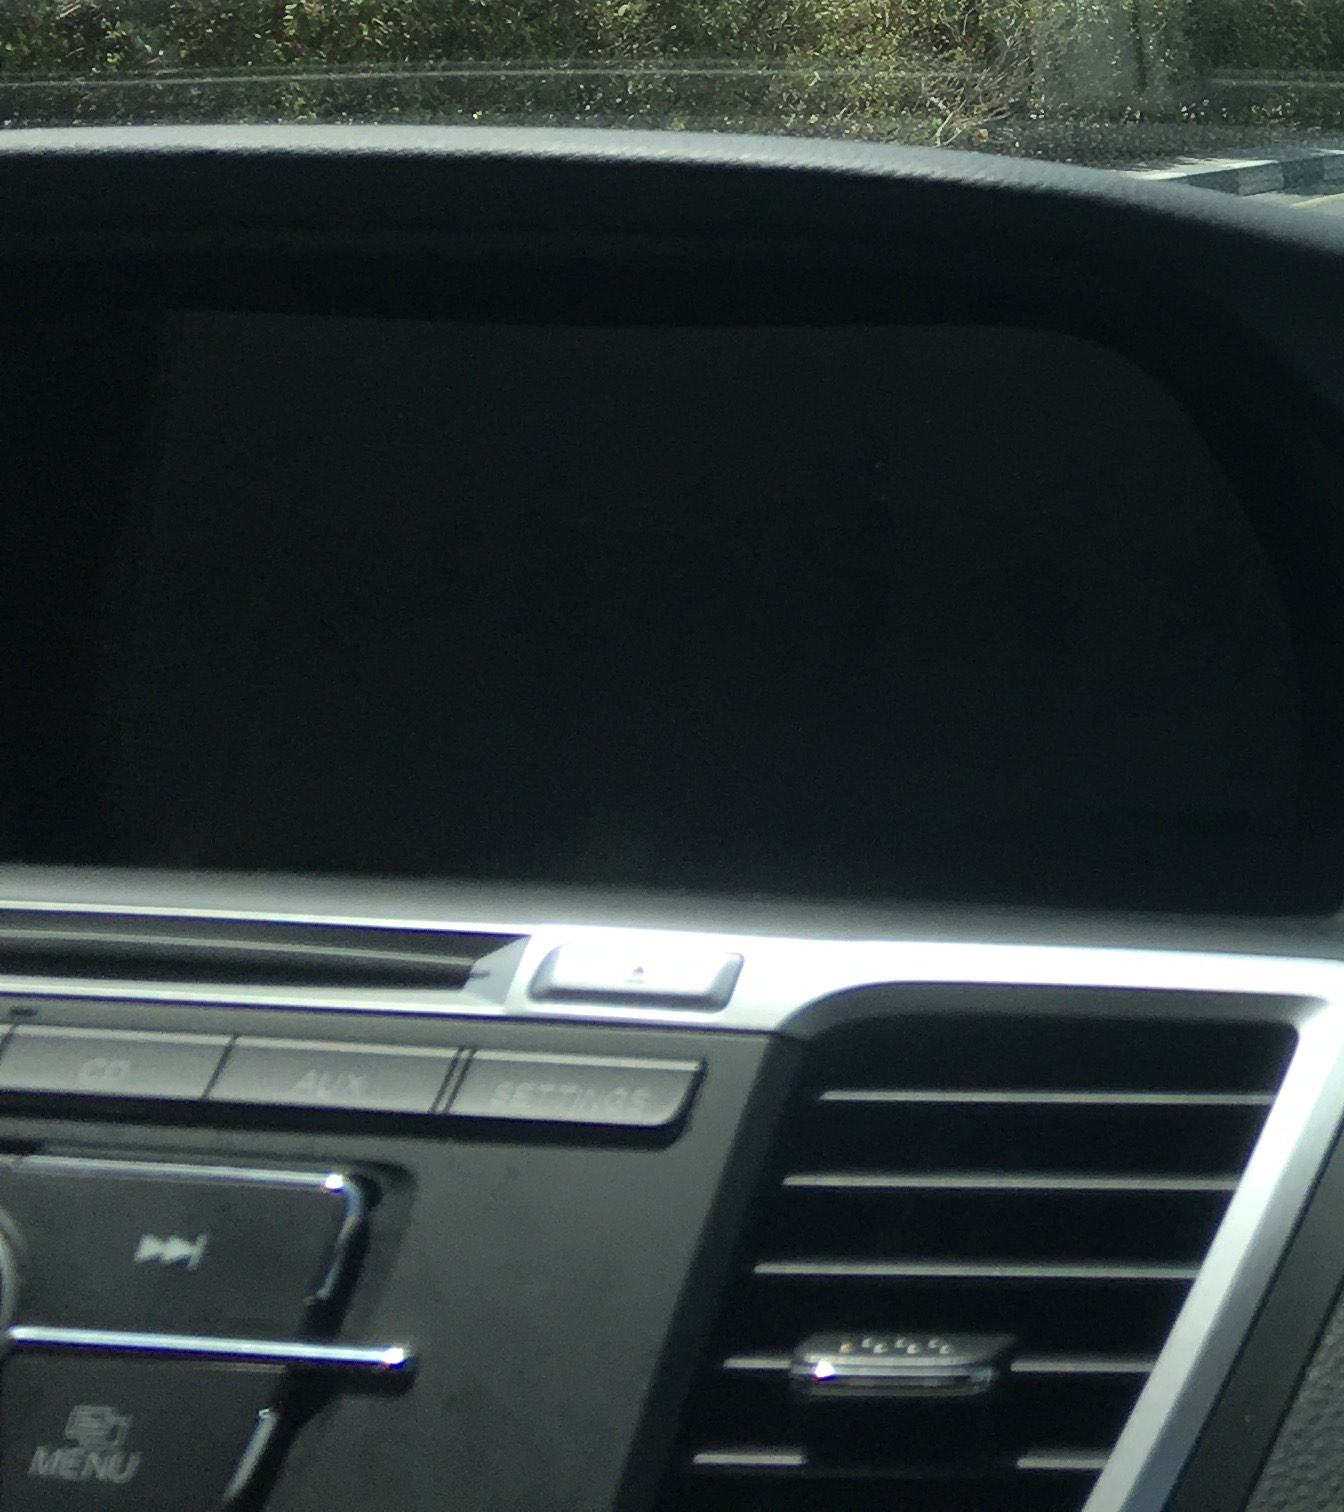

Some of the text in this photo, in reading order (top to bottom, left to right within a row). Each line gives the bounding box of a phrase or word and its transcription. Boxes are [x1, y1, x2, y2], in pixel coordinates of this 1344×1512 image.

[291, 1067, 371, 1099] AUX
[490, 1079, 652, 1116] SETTINGS
[27, 1445, 144, 1484] MENU
